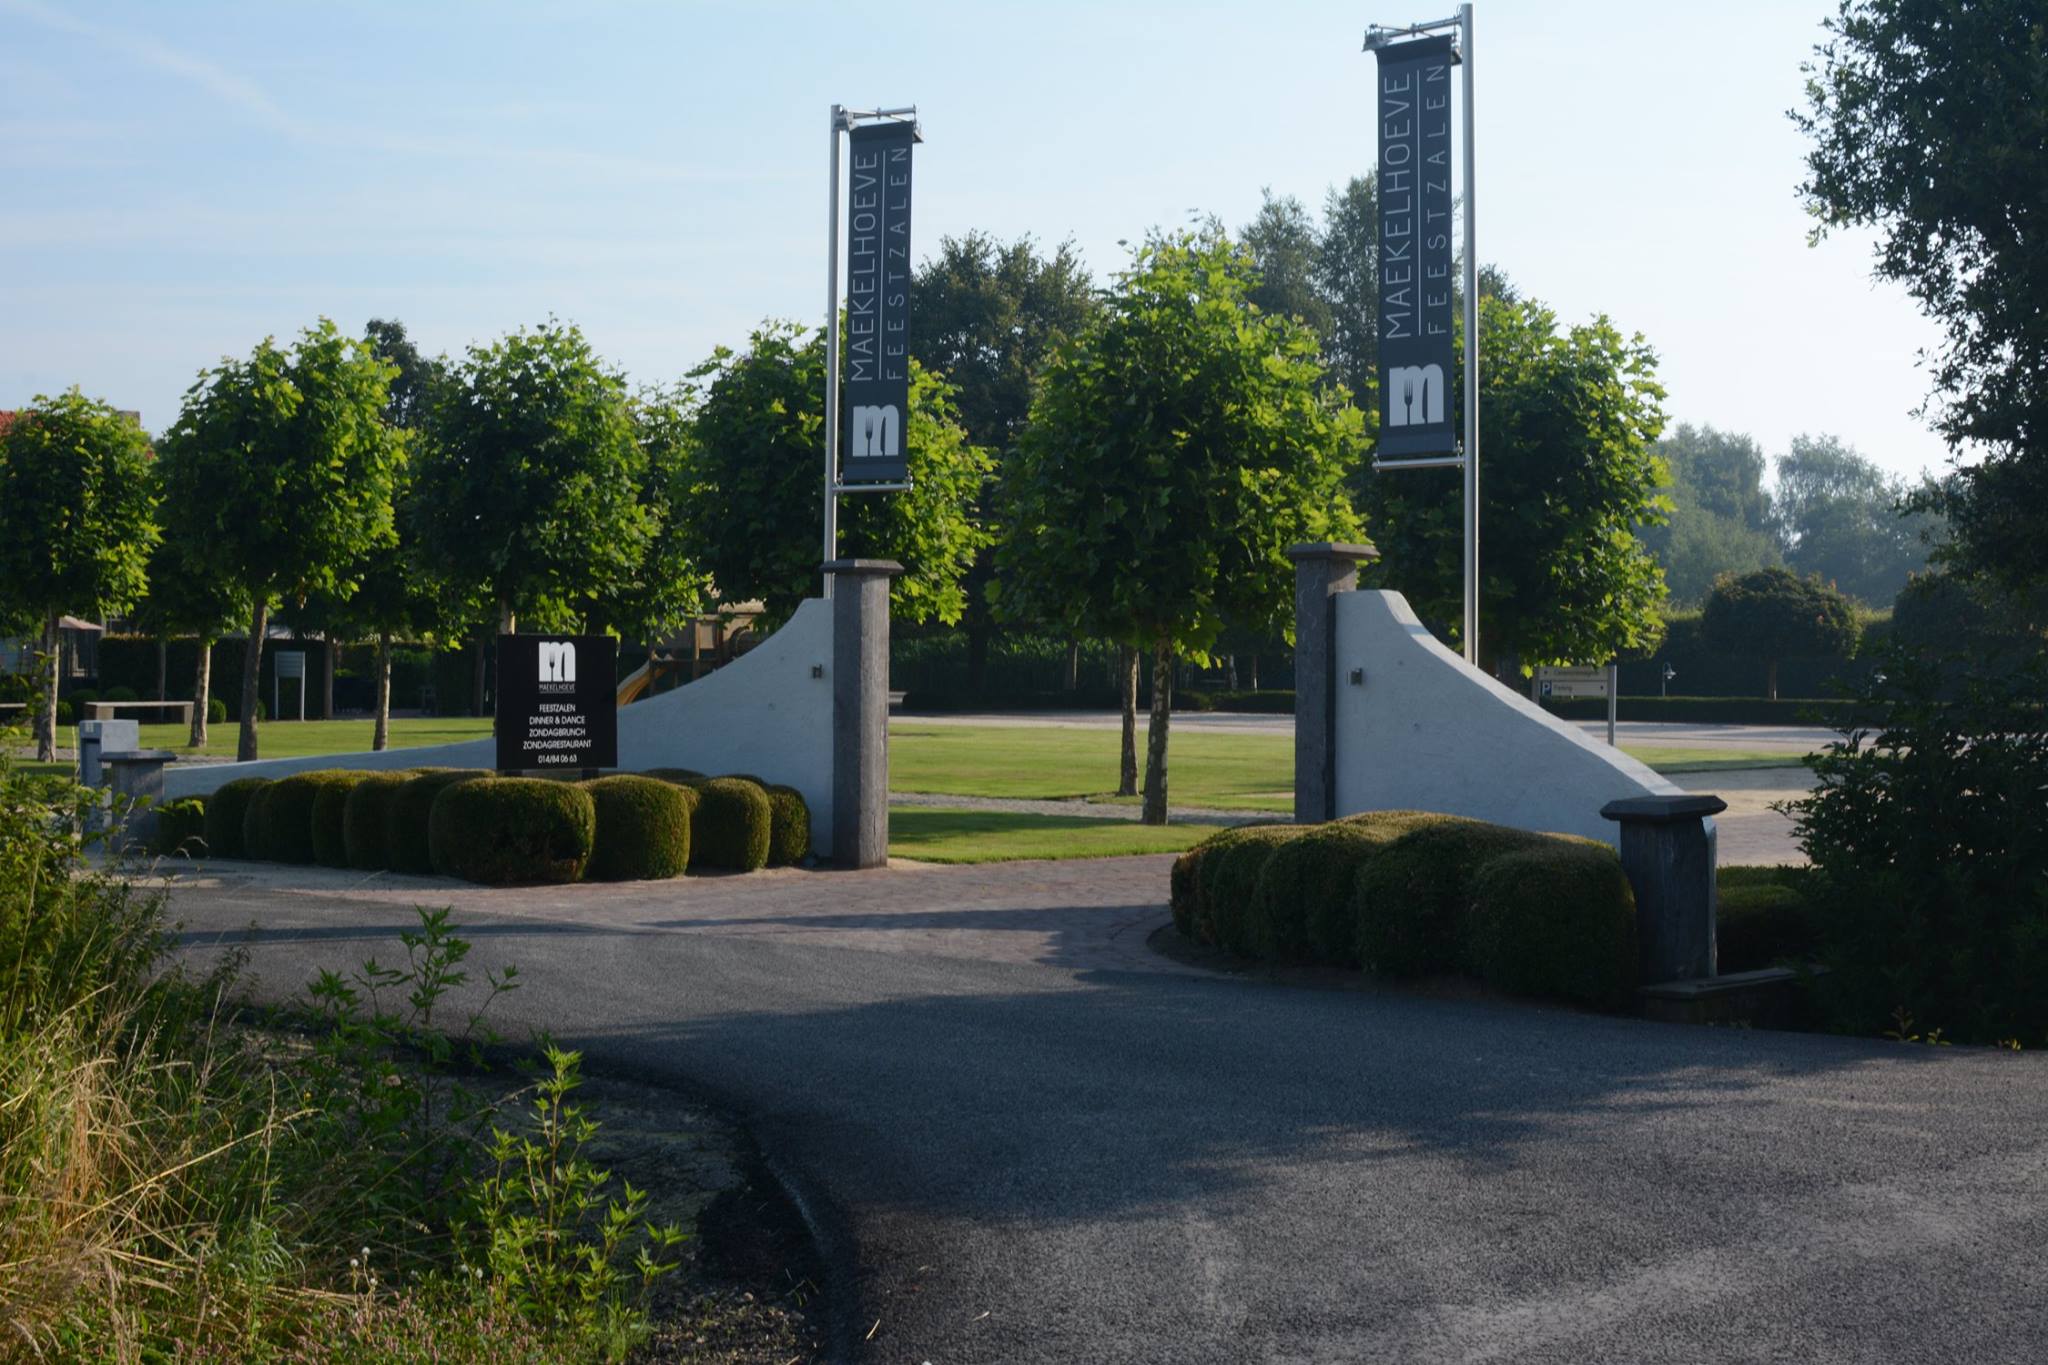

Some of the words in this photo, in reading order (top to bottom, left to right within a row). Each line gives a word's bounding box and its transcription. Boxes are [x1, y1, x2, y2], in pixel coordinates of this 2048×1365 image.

[1384, 73, 1411, 339] MAEKELHOEVE
[1426, 65, 1447, 335] FEESTZALEN
[851, 152, 877, 381] MAEKELHOEVE
[887, 148, 907, 380] FEESTZALEN
[523, 740, 592, 750] ZONDAGRESTAURANT
[529, 717, 554, 725] DINNER
[555, 716, 561, 725] &
[562, 715, 586, 725] DANCE
[529, 728, 586, 737] ZONDAGBRUNCH
[539, 704, 576, 713] FEESTZALEN
